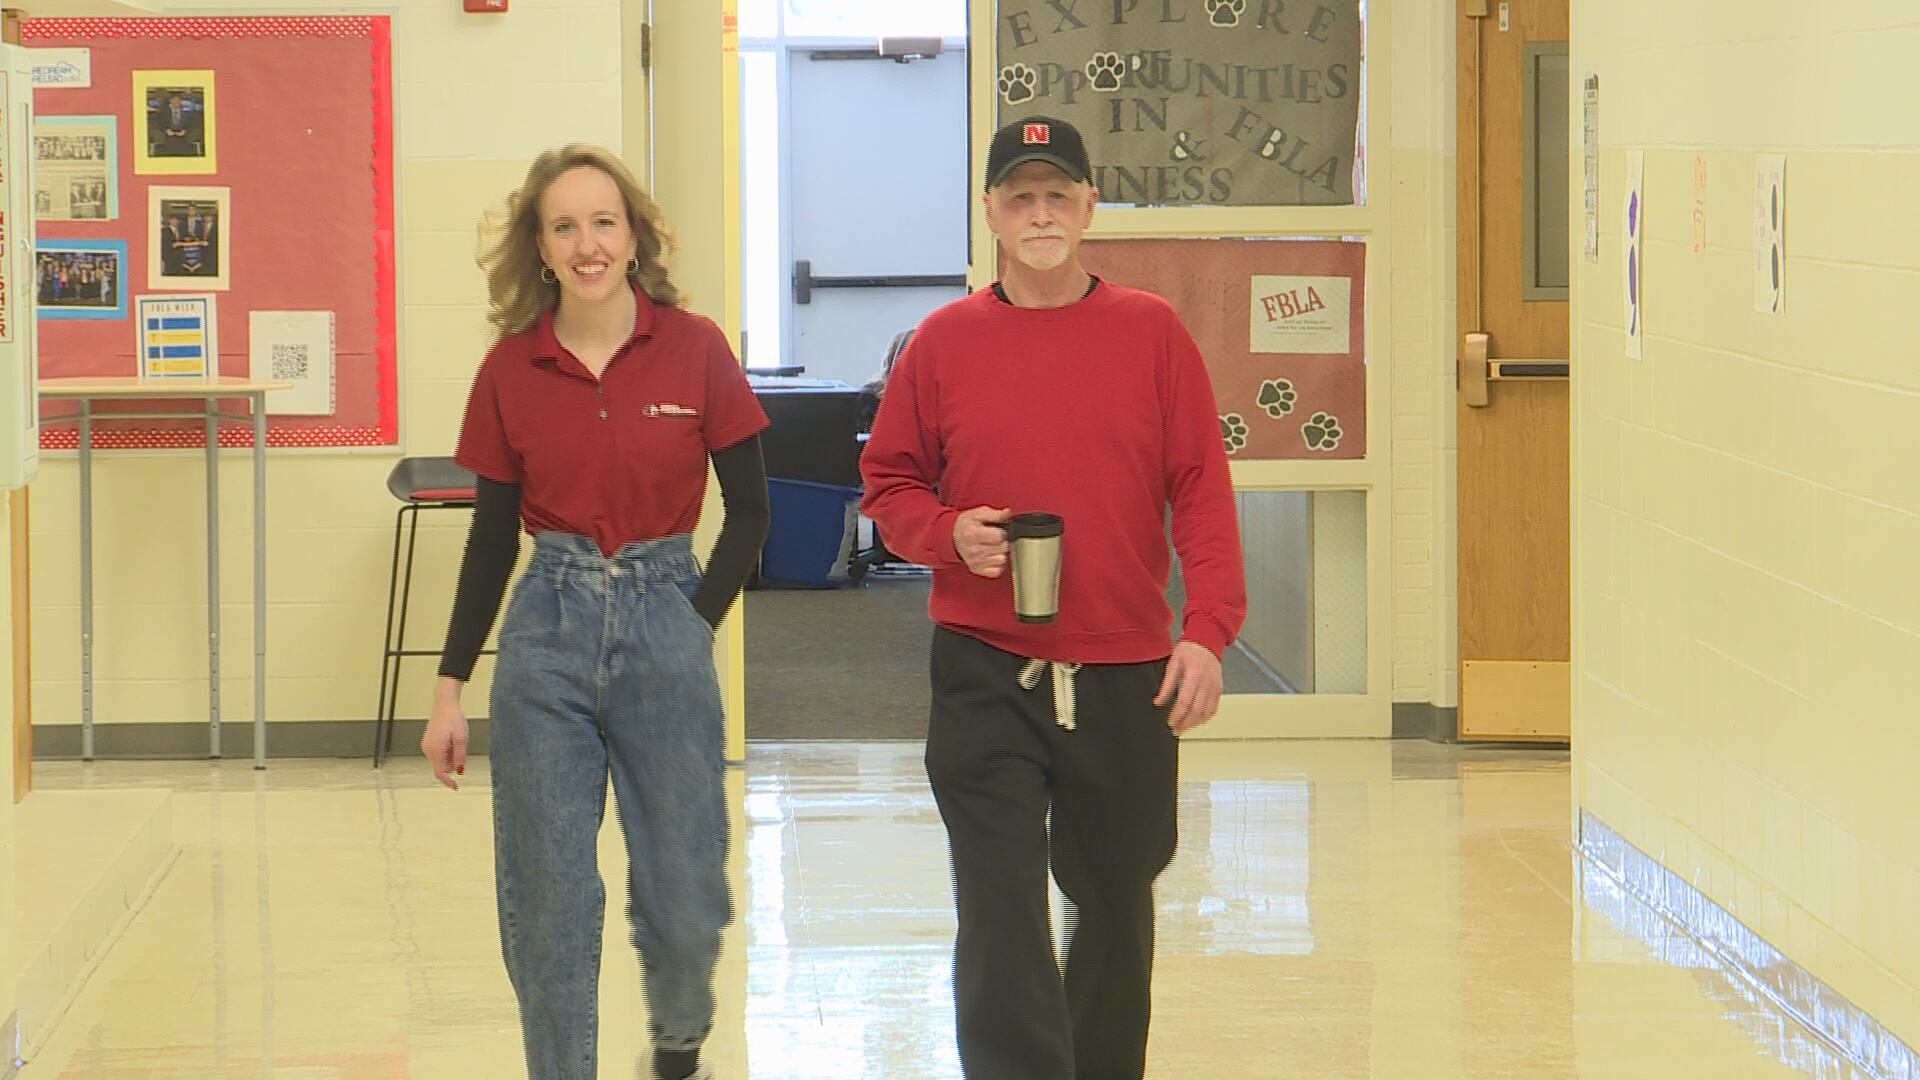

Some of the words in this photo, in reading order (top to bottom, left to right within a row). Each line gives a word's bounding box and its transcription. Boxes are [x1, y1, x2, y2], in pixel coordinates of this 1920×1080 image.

[1108, 98, 1169, 133] IN
[1023, 123, 1050, 144] N
[1224, 106, 1341, 193] FBLA
[1259, 286, 1326, 322] FBLA
